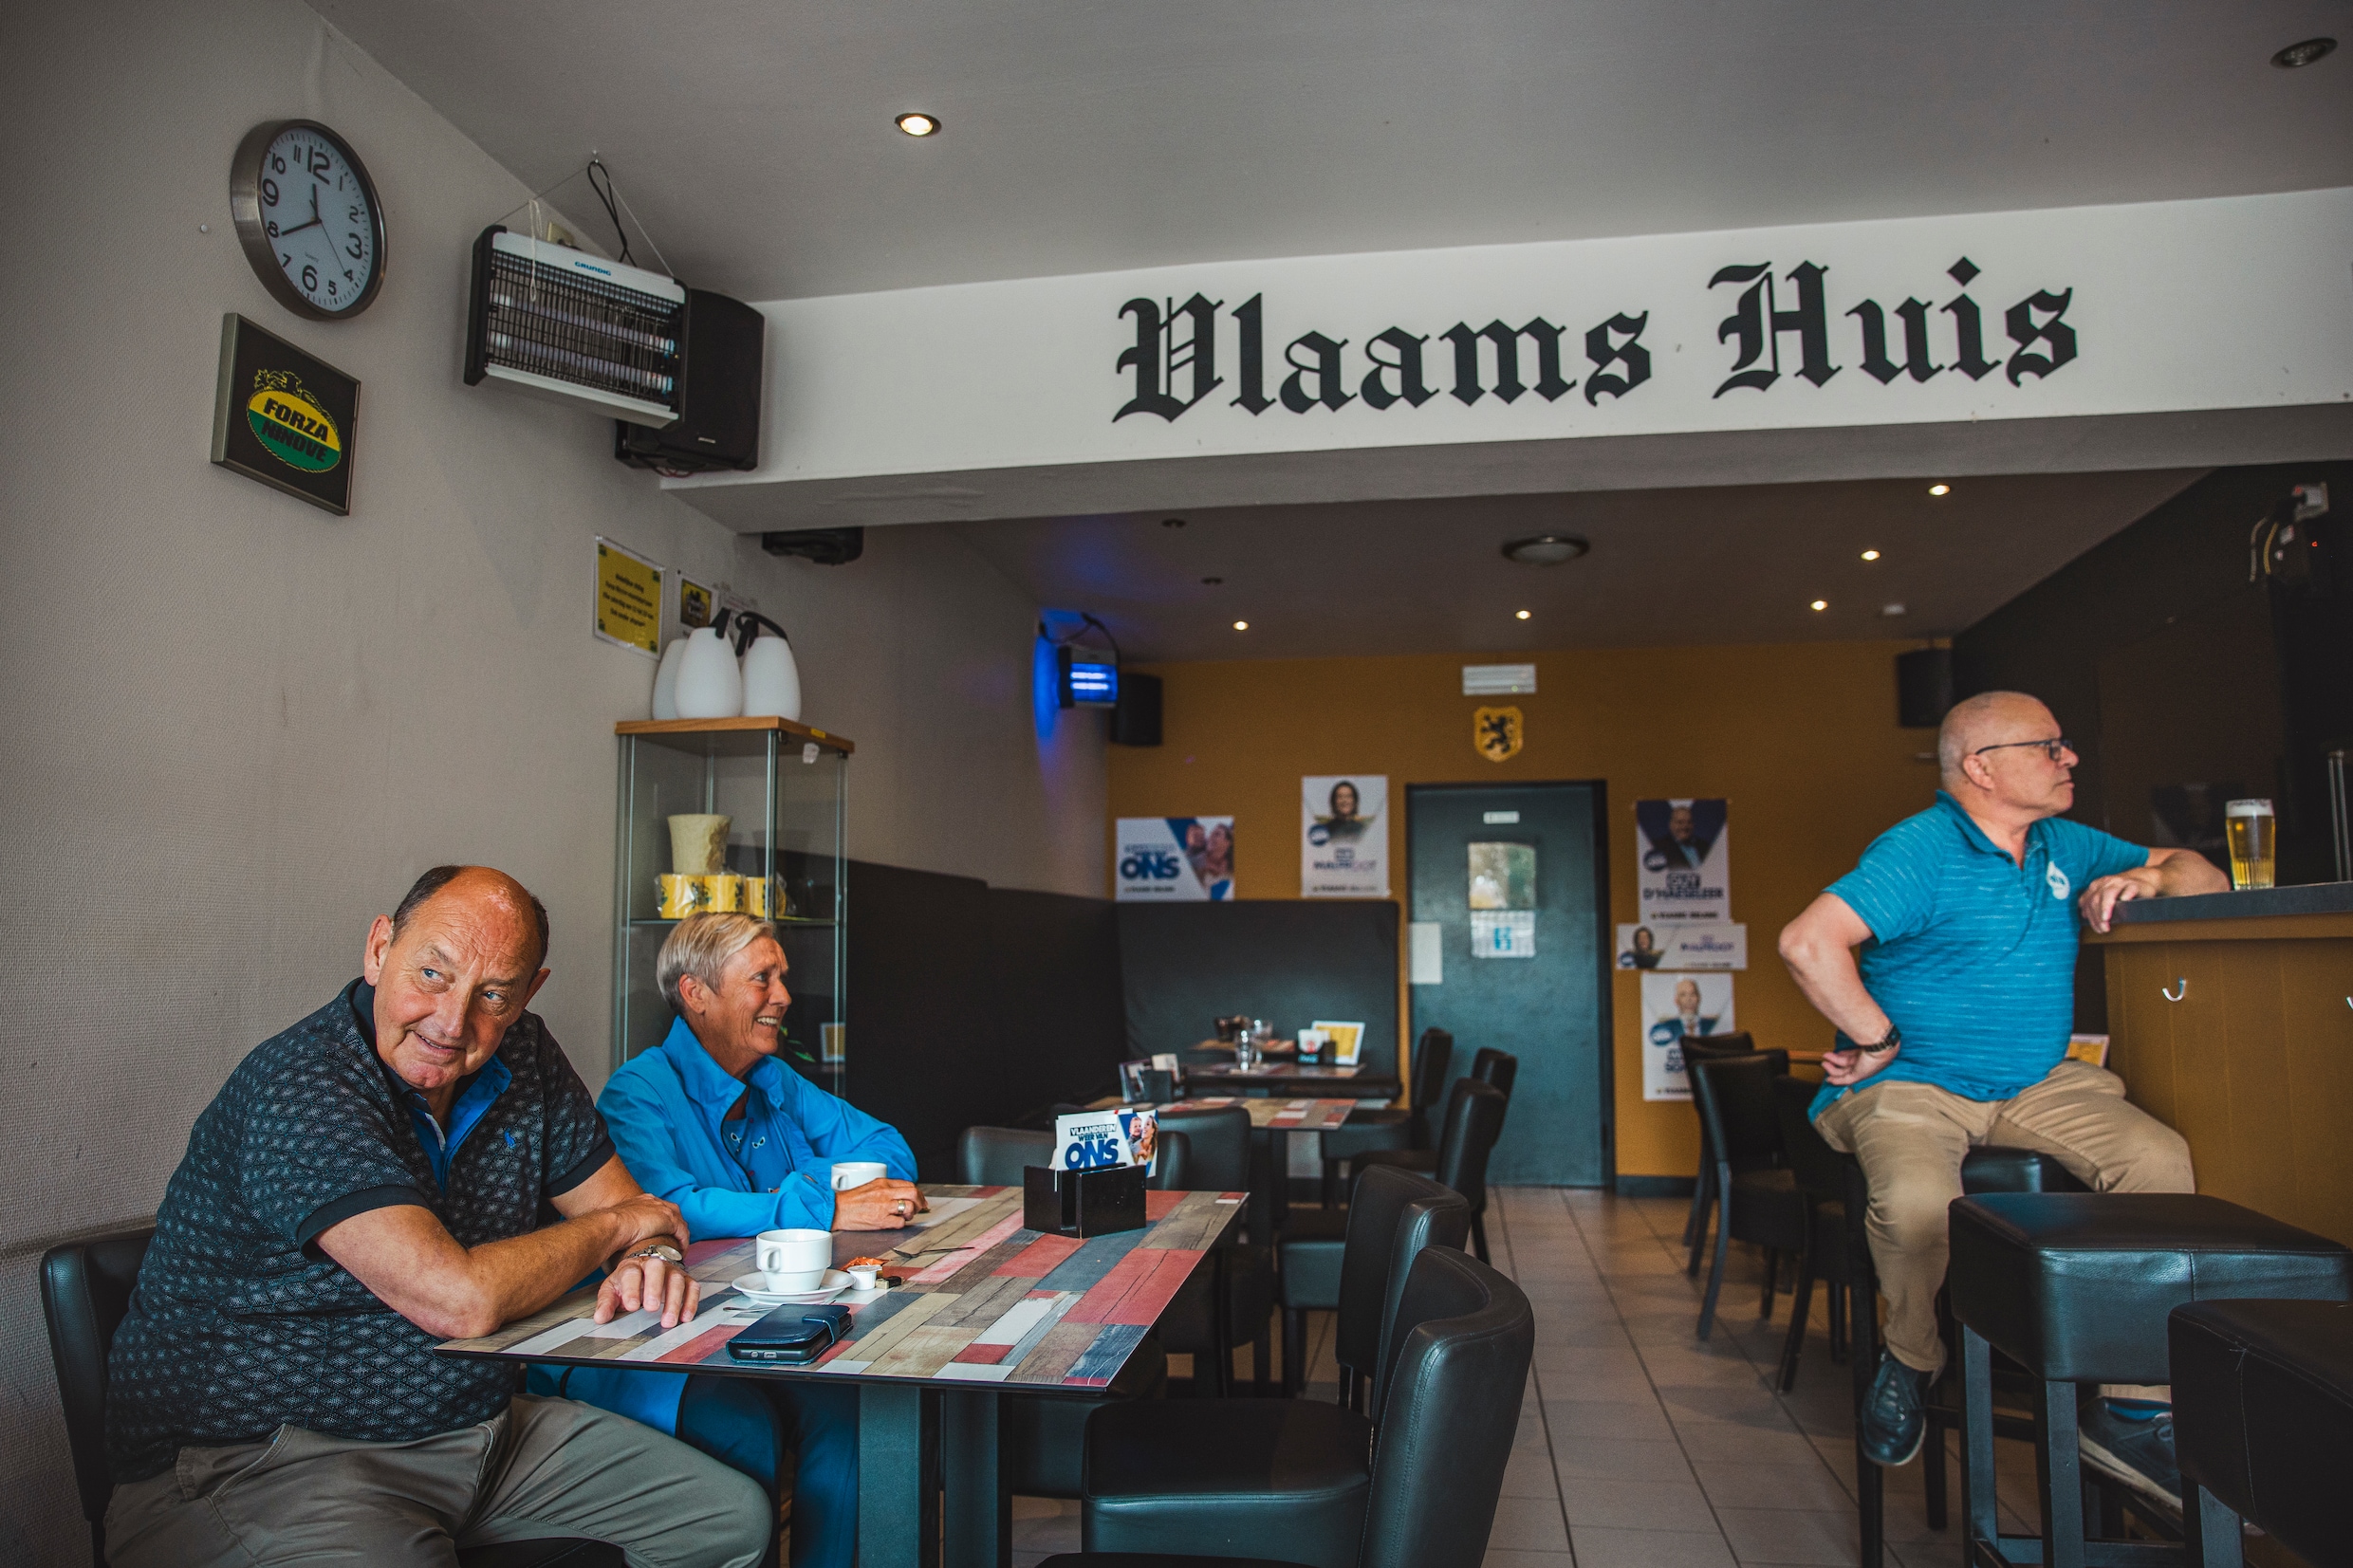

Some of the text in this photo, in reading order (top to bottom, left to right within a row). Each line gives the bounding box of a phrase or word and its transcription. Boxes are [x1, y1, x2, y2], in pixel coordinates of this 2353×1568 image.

[271, 153, 286, 175] 10
[293, 144, 302, 164] 11
[307, 145, 330, 185] 12
[262, 178, 279, 207] 9
[339, 175, 343, 192] 1
[348, 206, 359, 224] 2
[267, 221, 279, 238] 8
[345, 232, 362, 260] 3
[282, 253, 291, 268] 7
[574, 260, 612, 276] GRUNDIG
[302, 265, 318, 293] 6
[343, 269, 354, 283] 4
[327, 279, 337, 296] 5
[1112, 255, 2079, 423] Vlaams Huis
[263, 397, 328, 443] FORZA
[261, 419, 328, 463] NINOVE
[1121, 856, 1180, 880] ONS
[1069, 1124, 1117, 1136] VLAANDEREN
[1065, 1137, 1120, 1171] ONS
